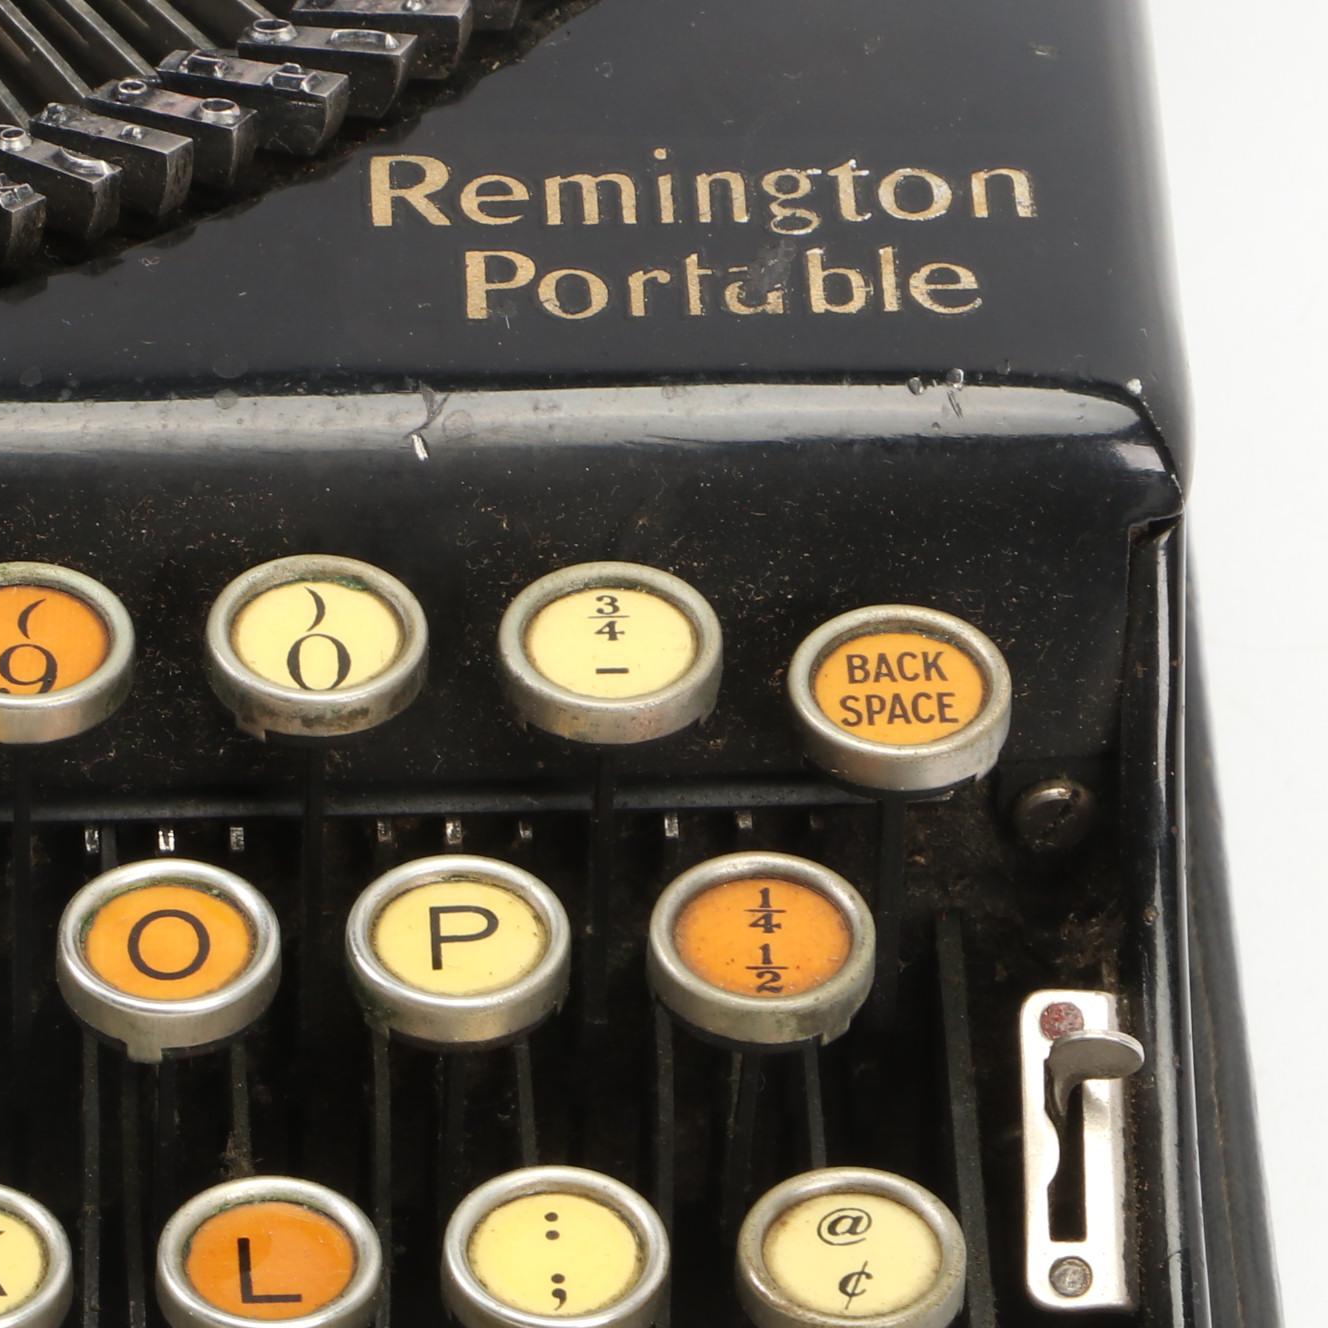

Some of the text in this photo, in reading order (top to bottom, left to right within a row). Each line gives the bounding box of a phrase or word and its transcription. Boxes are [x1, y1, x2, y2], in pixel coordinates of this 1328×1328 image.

[369, 147, 1038, 236] Remington
[463, 245, 984, 321] Portable
[846, 651, 947, 684] BACK
[839, 691, 959, 727] SPACE
[127, 909, 210, 981] O
[429, 905, 499, 971] P
[816, 1205, 875, 1247] @
[237, 1237, 302, 1304] L
[837, 1260, 872, 1311] ¢
